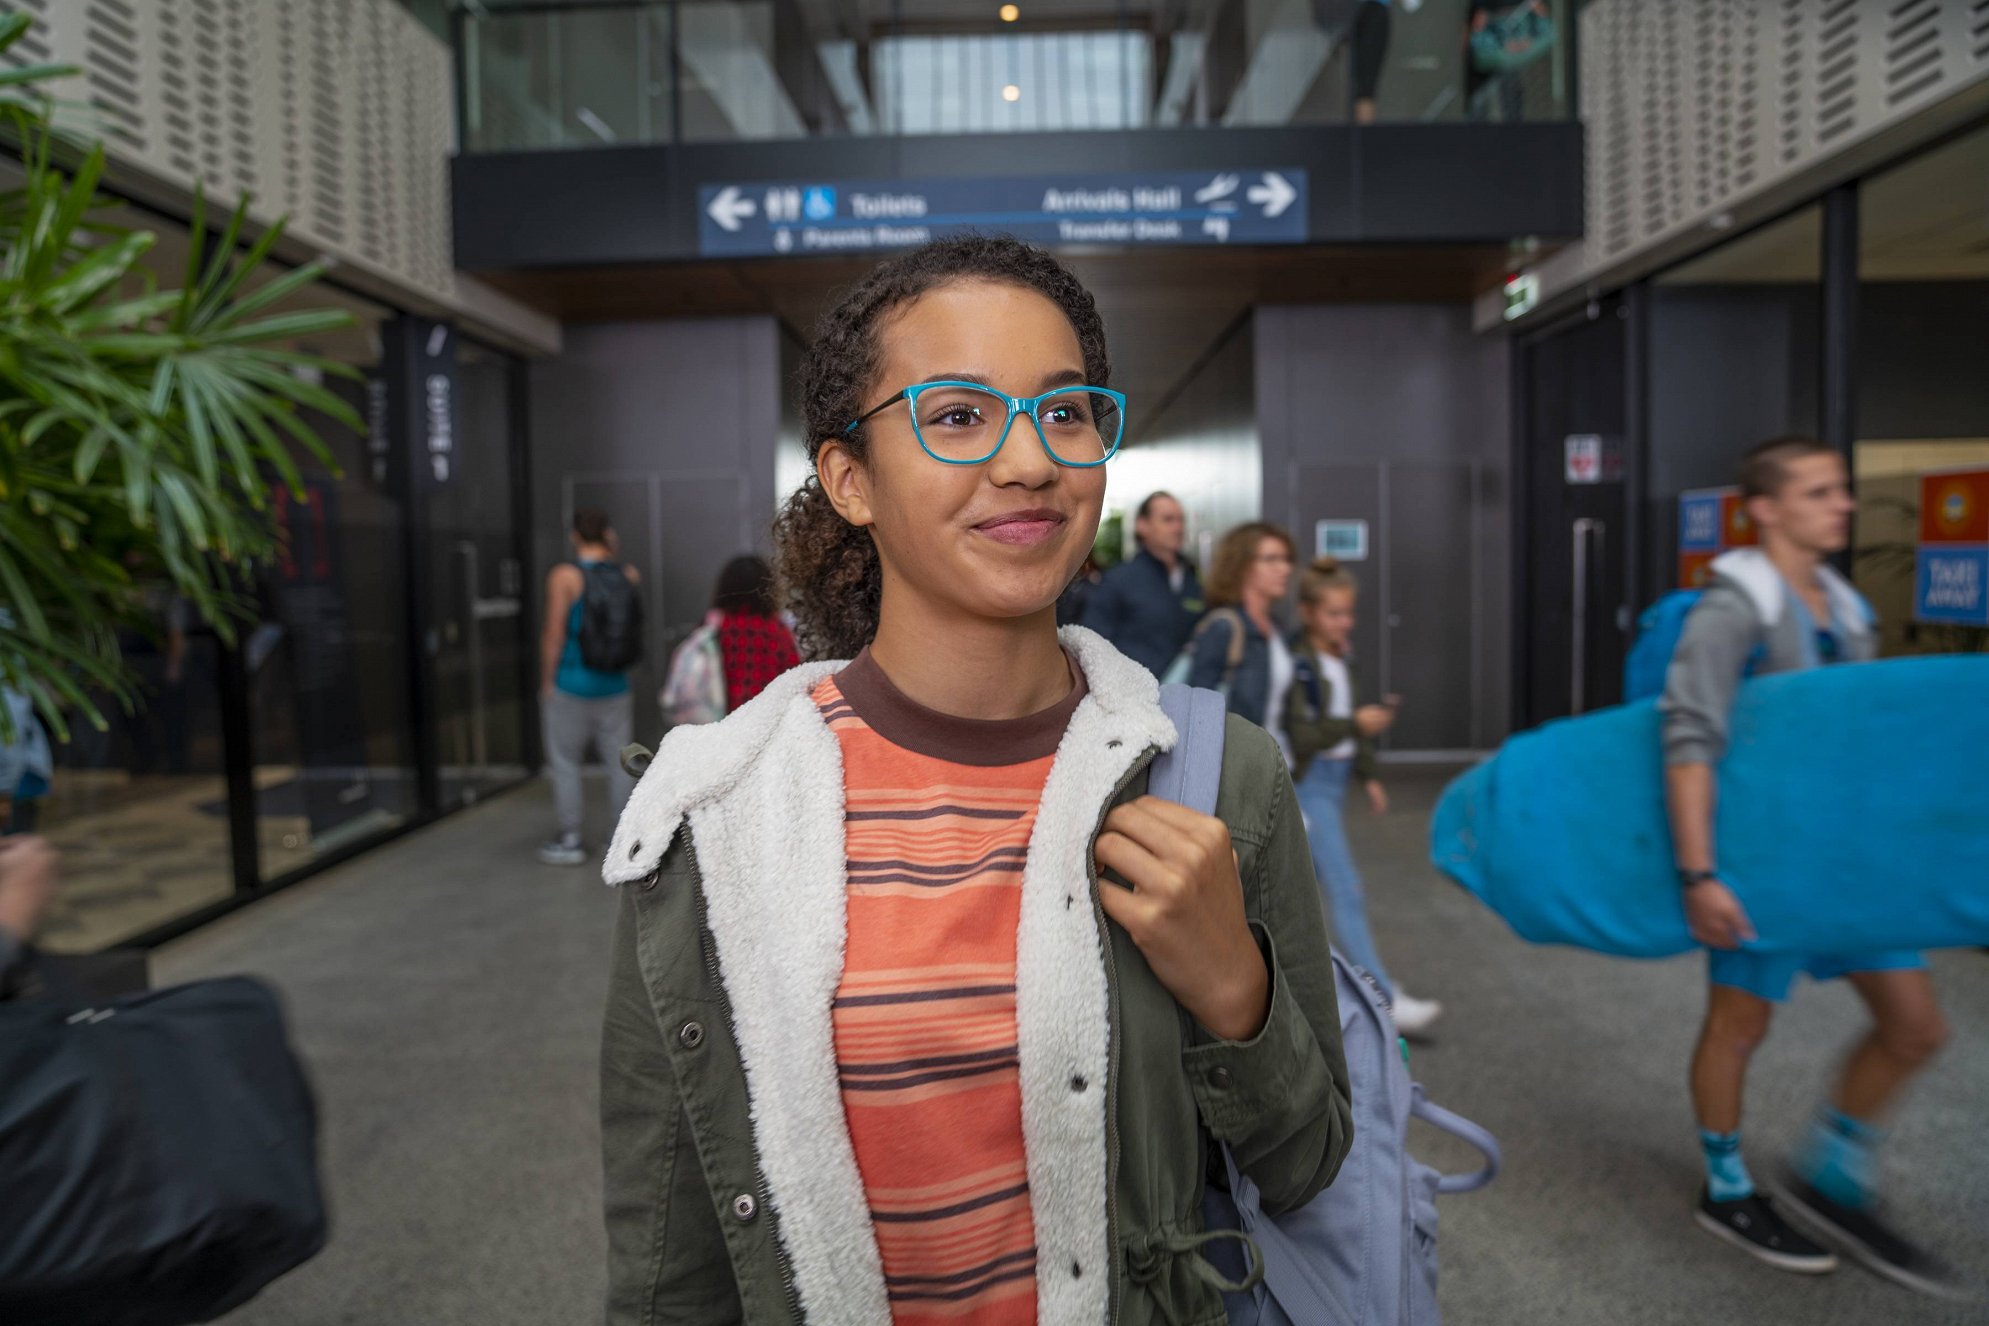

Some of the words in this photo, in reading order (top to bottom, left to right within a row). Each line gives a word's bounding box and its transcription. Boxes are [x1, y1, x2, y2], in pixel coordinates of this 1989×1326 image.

[850, 193, 928, 219] Toilets
[1042, 187, 1131, 212] Arrivals
[1132, 185, 1181, 211] Hall
[802, 227, 872, 247] Parents
[873, 225, 930, 246] Room
[1058, 218, 1131, 240] Transfer
[1132, 217, 1182, 240] Desk
[1929, 557, 1979, 583] TAKE
[1925, 584, 1982, 609] AWAY
